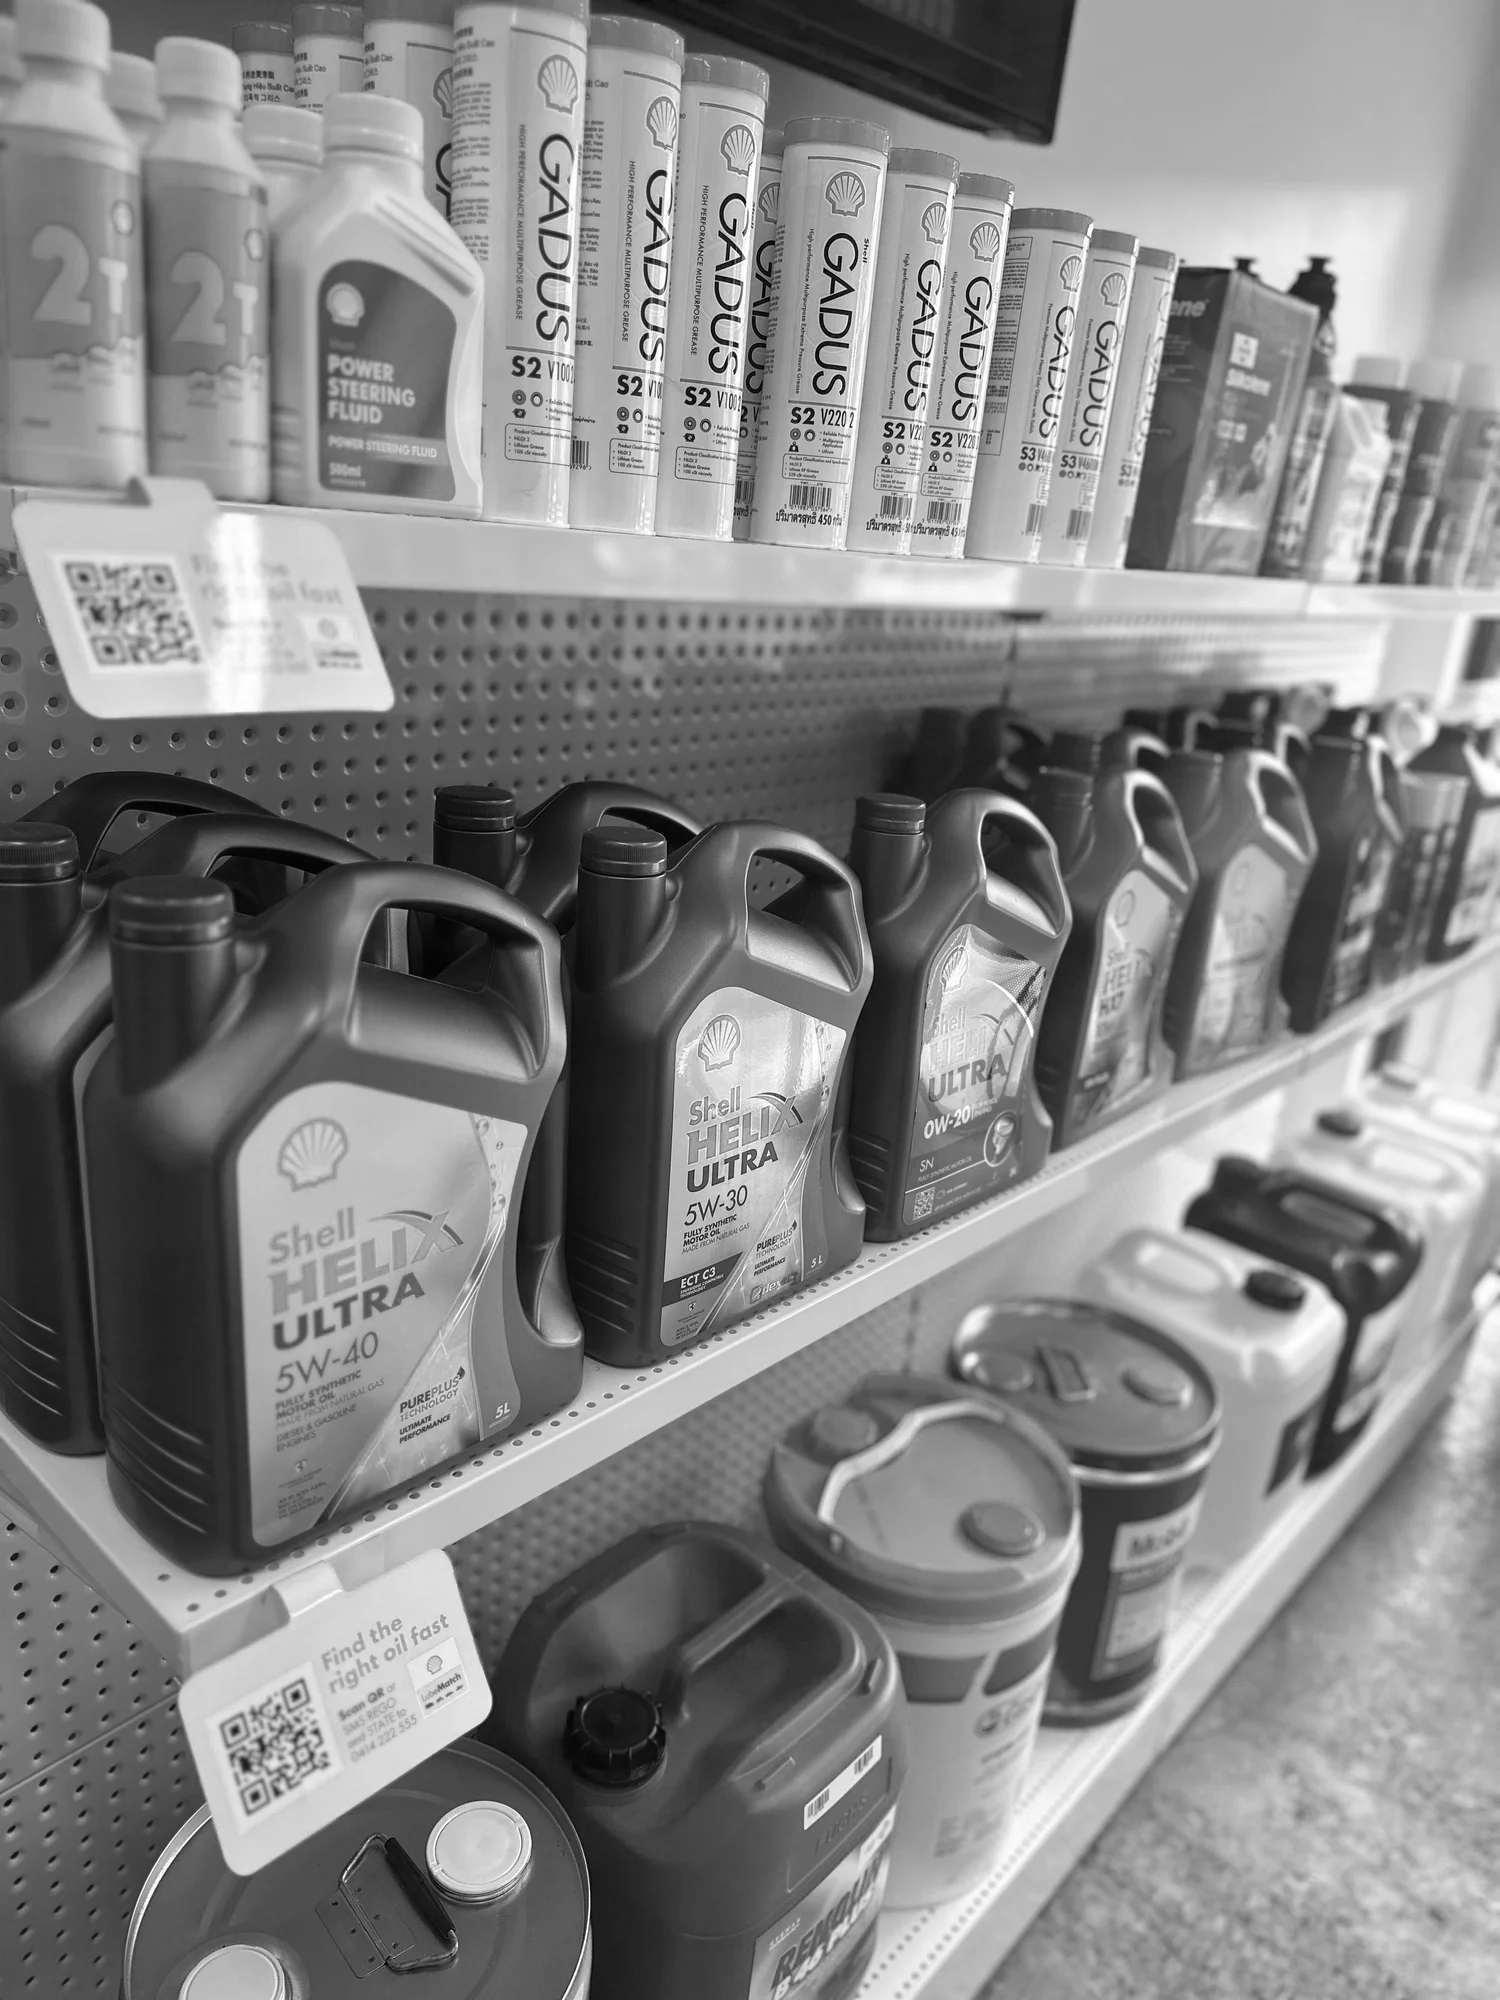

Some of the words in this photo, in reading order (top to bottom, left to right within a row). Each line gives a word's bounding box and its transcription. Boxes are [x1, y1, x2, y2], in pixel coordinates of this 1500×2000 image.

[518, 124, 526, 148] HIGH
[516, 150, 526, 219] PERFORMANCE
[628, 160, 636, 183] HIGH
[701, 184, 709, 205] HIGH
[625, 184, 635, 248] PERFORMANCE
[535, 133, 576, 343] GADUS
[698, 205, 708, 266] PERFORMANCE
[807, 228, 815, 243] High
[862, 237, 870, 265] Shell
[515, 221, 525, 287] MULTIPURPOSE
[638, 169, 673, 362] GADUS
[622, 248, 632, 309] MULTIPURPOSE
[708, 192, 749, 376] GADUS
[514, 288, 523, 321] GREASE
[692, 266, 703, 326] MULTIPURPOSE
[621, 310, 630, 343] GREASE
[812, 232, 859, 396] GADUS
[690, 326, 699, 356] GREASE
[903, 259, 942, 412] GADUS
[951, 275, 993, 422] GADUS
[328, 353, 395, 383] POWER
[511, 355, 542, 379] S2
[1039, 305, 1076, 438] GADUS
[1079, 320, 1119, 447] GADUS
[327, 376, 416, 407] STEERING
[617, 374, 643, 397] S2
[684, 386, 712, 408] S2
[794, 373, 803, 395] Grease
[328, 400, 383, 424] FLUID
[790, 406, 815, 425] S2
[821, 408, 846, 427] V220
[328, 435, 364, 450] POWER
[366, 439, 410, 455] STEERING
[411, 445, 437, 459] FLUID
[883, 421, 906, 440] S2
[930, 431, 953, 448] S2
[1020, 446, 1036, 461] S3
[1060, 455, 1077, 469] S3
[817, 514, 832, 527] 450
[932, 1006, 968, 1038] Shell
[929, 1053, 1008, 1103] ULTRA
[689, 1086, 741, 1126] Shell
[924, 1104, 971, 1139] 0W-20
[687, 1092, 803, 1166] HELIX
[687, 1141, 779, 1193] ULTRA
[919, 1157, 935, 1173] SN
[684, 1184, 748, 1226] 5W-30
[269, 1206, 355, 1265] Shell
[682, 1243, 699, 1255] MADE
[700, 1238, 715, 1249] FROM
[716, 1228, 738, 1241] NATURAL
[739, 1222, 750, 1232] GAS
[683, 1227, 703, 1240] FULLY
[704, 1213, 737, 1232] SYNTHETIC
[683, 1233, 709, 1247] MOTOR
[710, 1228, 720, 1238] OIL
[756, 1227, 793, 1252] PUREPLUS
[267, 1210, 464, 1316] HELIX
[754, 1256, 775, 1270] ULTIMATE
[755, 1237, 792, 1259] TECHNOLOGY
[681, 1272, 700, 1289] ECT
[702, 1266, 716, 1280] C3
[753, 1257, 786, 1276] PERFORMANCE
[273, 1271, 426, 1351] ULTRA
[275, 1331, 379, 1394] 5W-40
[275, 1393, 305, 1411] FULLY
[308, 1369, 362, 1399] SYNTHETIC
[276, 1414, 302, 1430] MADE
[304, 1403, 329, 1419] FROM
[330, 1387, 366, 1407] NATURAL
[367, 1378, 385, 1392] GAS
[276, 1399, 316, 1420] MOTOR
[318, 1391, 336, 1404] OIL
[400, 1376, 459, 1413] PUREPLUS
[400, 1387, 459, 1422] TECHNOLOGY
[276, 1426, 304, 1442] DIESEL
[314, 1403, 357, 1428] GASOLINE
[399, 1414, 432, 1436] ULTIMATE
[495, 1402, 511, 1419] 5L
[276, 1431, 317, 1452] ENGINES
[399, 1413, 451, 1444] PERFORMANCE
[321, 1631, 366, 1671] Find
[369, 1618, 403, 1644] the
[329, 1654, 380, 1694] right
[383, 1633, 408, 1662] oil
[410, 1613, 449, 1646] fast
[338, 1700, 366, 1721] Scan
[367, 1687, 386, 1704] QR
[386, 1682, 397, 1693] or
[421, 1673, 462, 1702] LubeMatch
[342, 1716, 366, 1736] SMS
[366, 1697, 397, 1719] REGO
[367, 1713, 396, 1737] STATE
[397, 1708, 407, 1719] to
[378, 1728, 398, 1747] 222
[399, 1714, 418, 1733] 555
